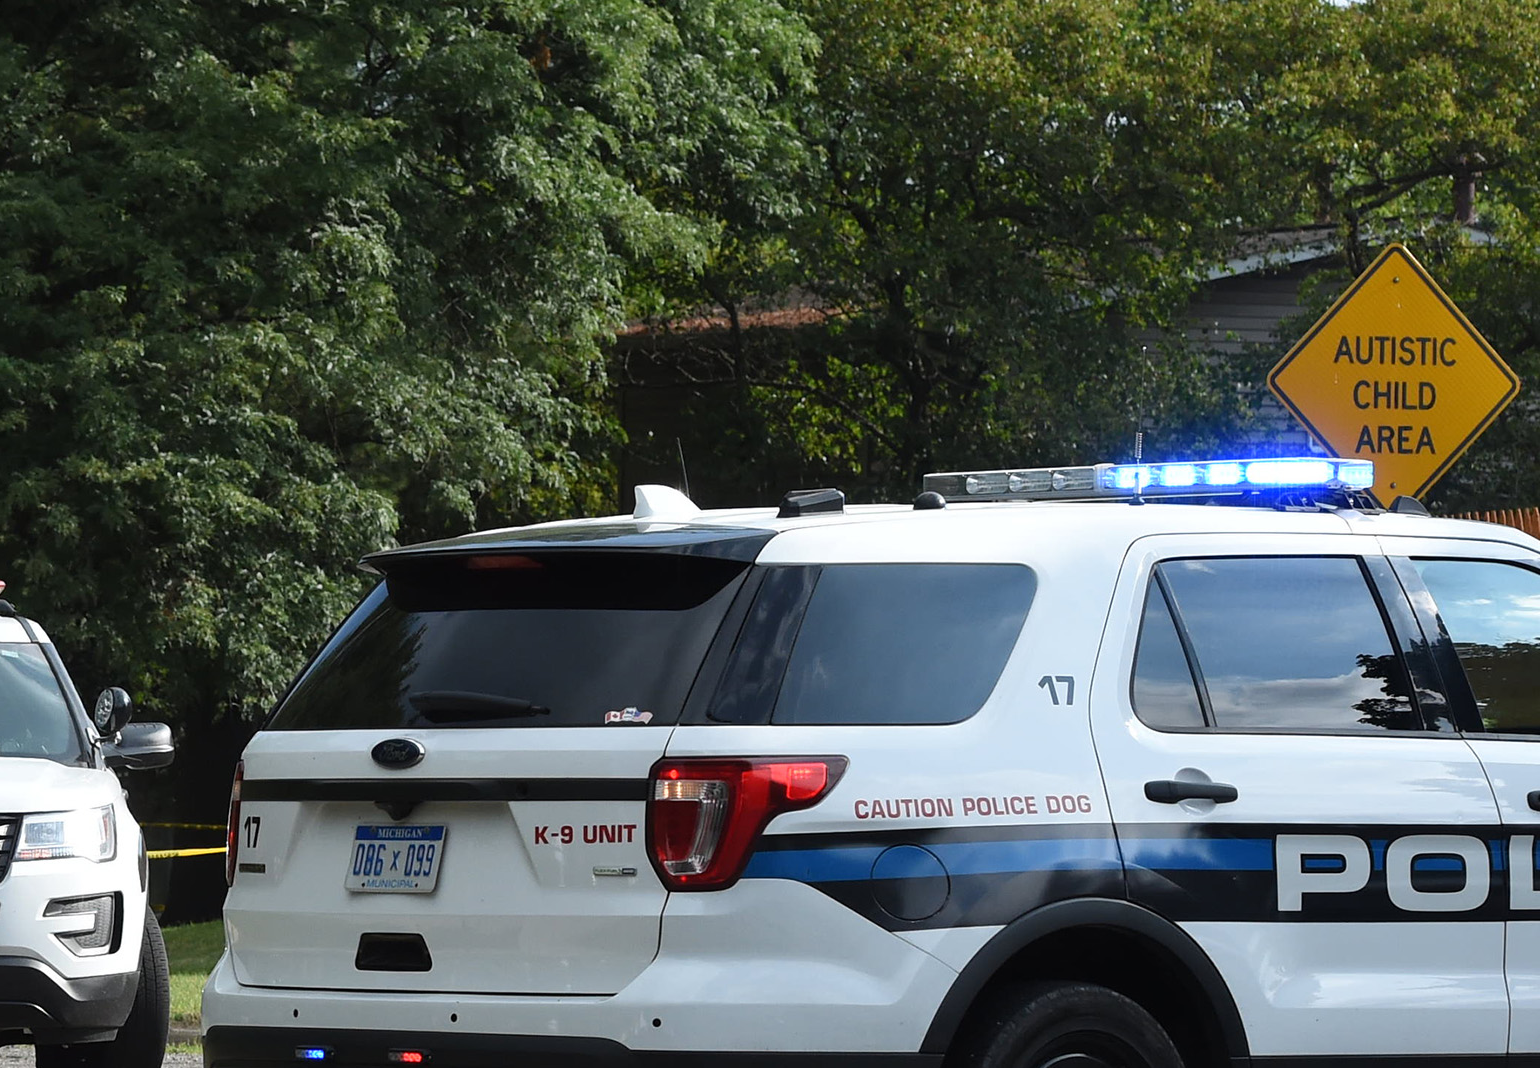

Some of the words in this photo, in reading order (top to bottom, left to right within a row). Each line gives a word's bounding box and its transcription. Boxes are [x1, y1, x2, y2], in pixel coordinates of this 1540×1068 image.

[1333, 335, 1457, 367] AUTISTIC
[1353, 380, 1437, 411] CHILD
[1355, 425, 1436, 455] AREA
[1037, 675, 1075, 706] 17
[854, 798, 954, 819] CAUTION
[962, 796, 1038, 816] POLICE
[1045, 795, 1092, 814] DOG
[244, 816, 261, 849] 17
[377, 828, 424, 839] MICHIGAN
[534, 825, 574, 845] K-9
[583, 824, 637, 844] UNIT
[353, 844, 387, 876] 086
[404, 844, 436, 876] 099
[367, 879, 414, 888] MUNICIPAL
